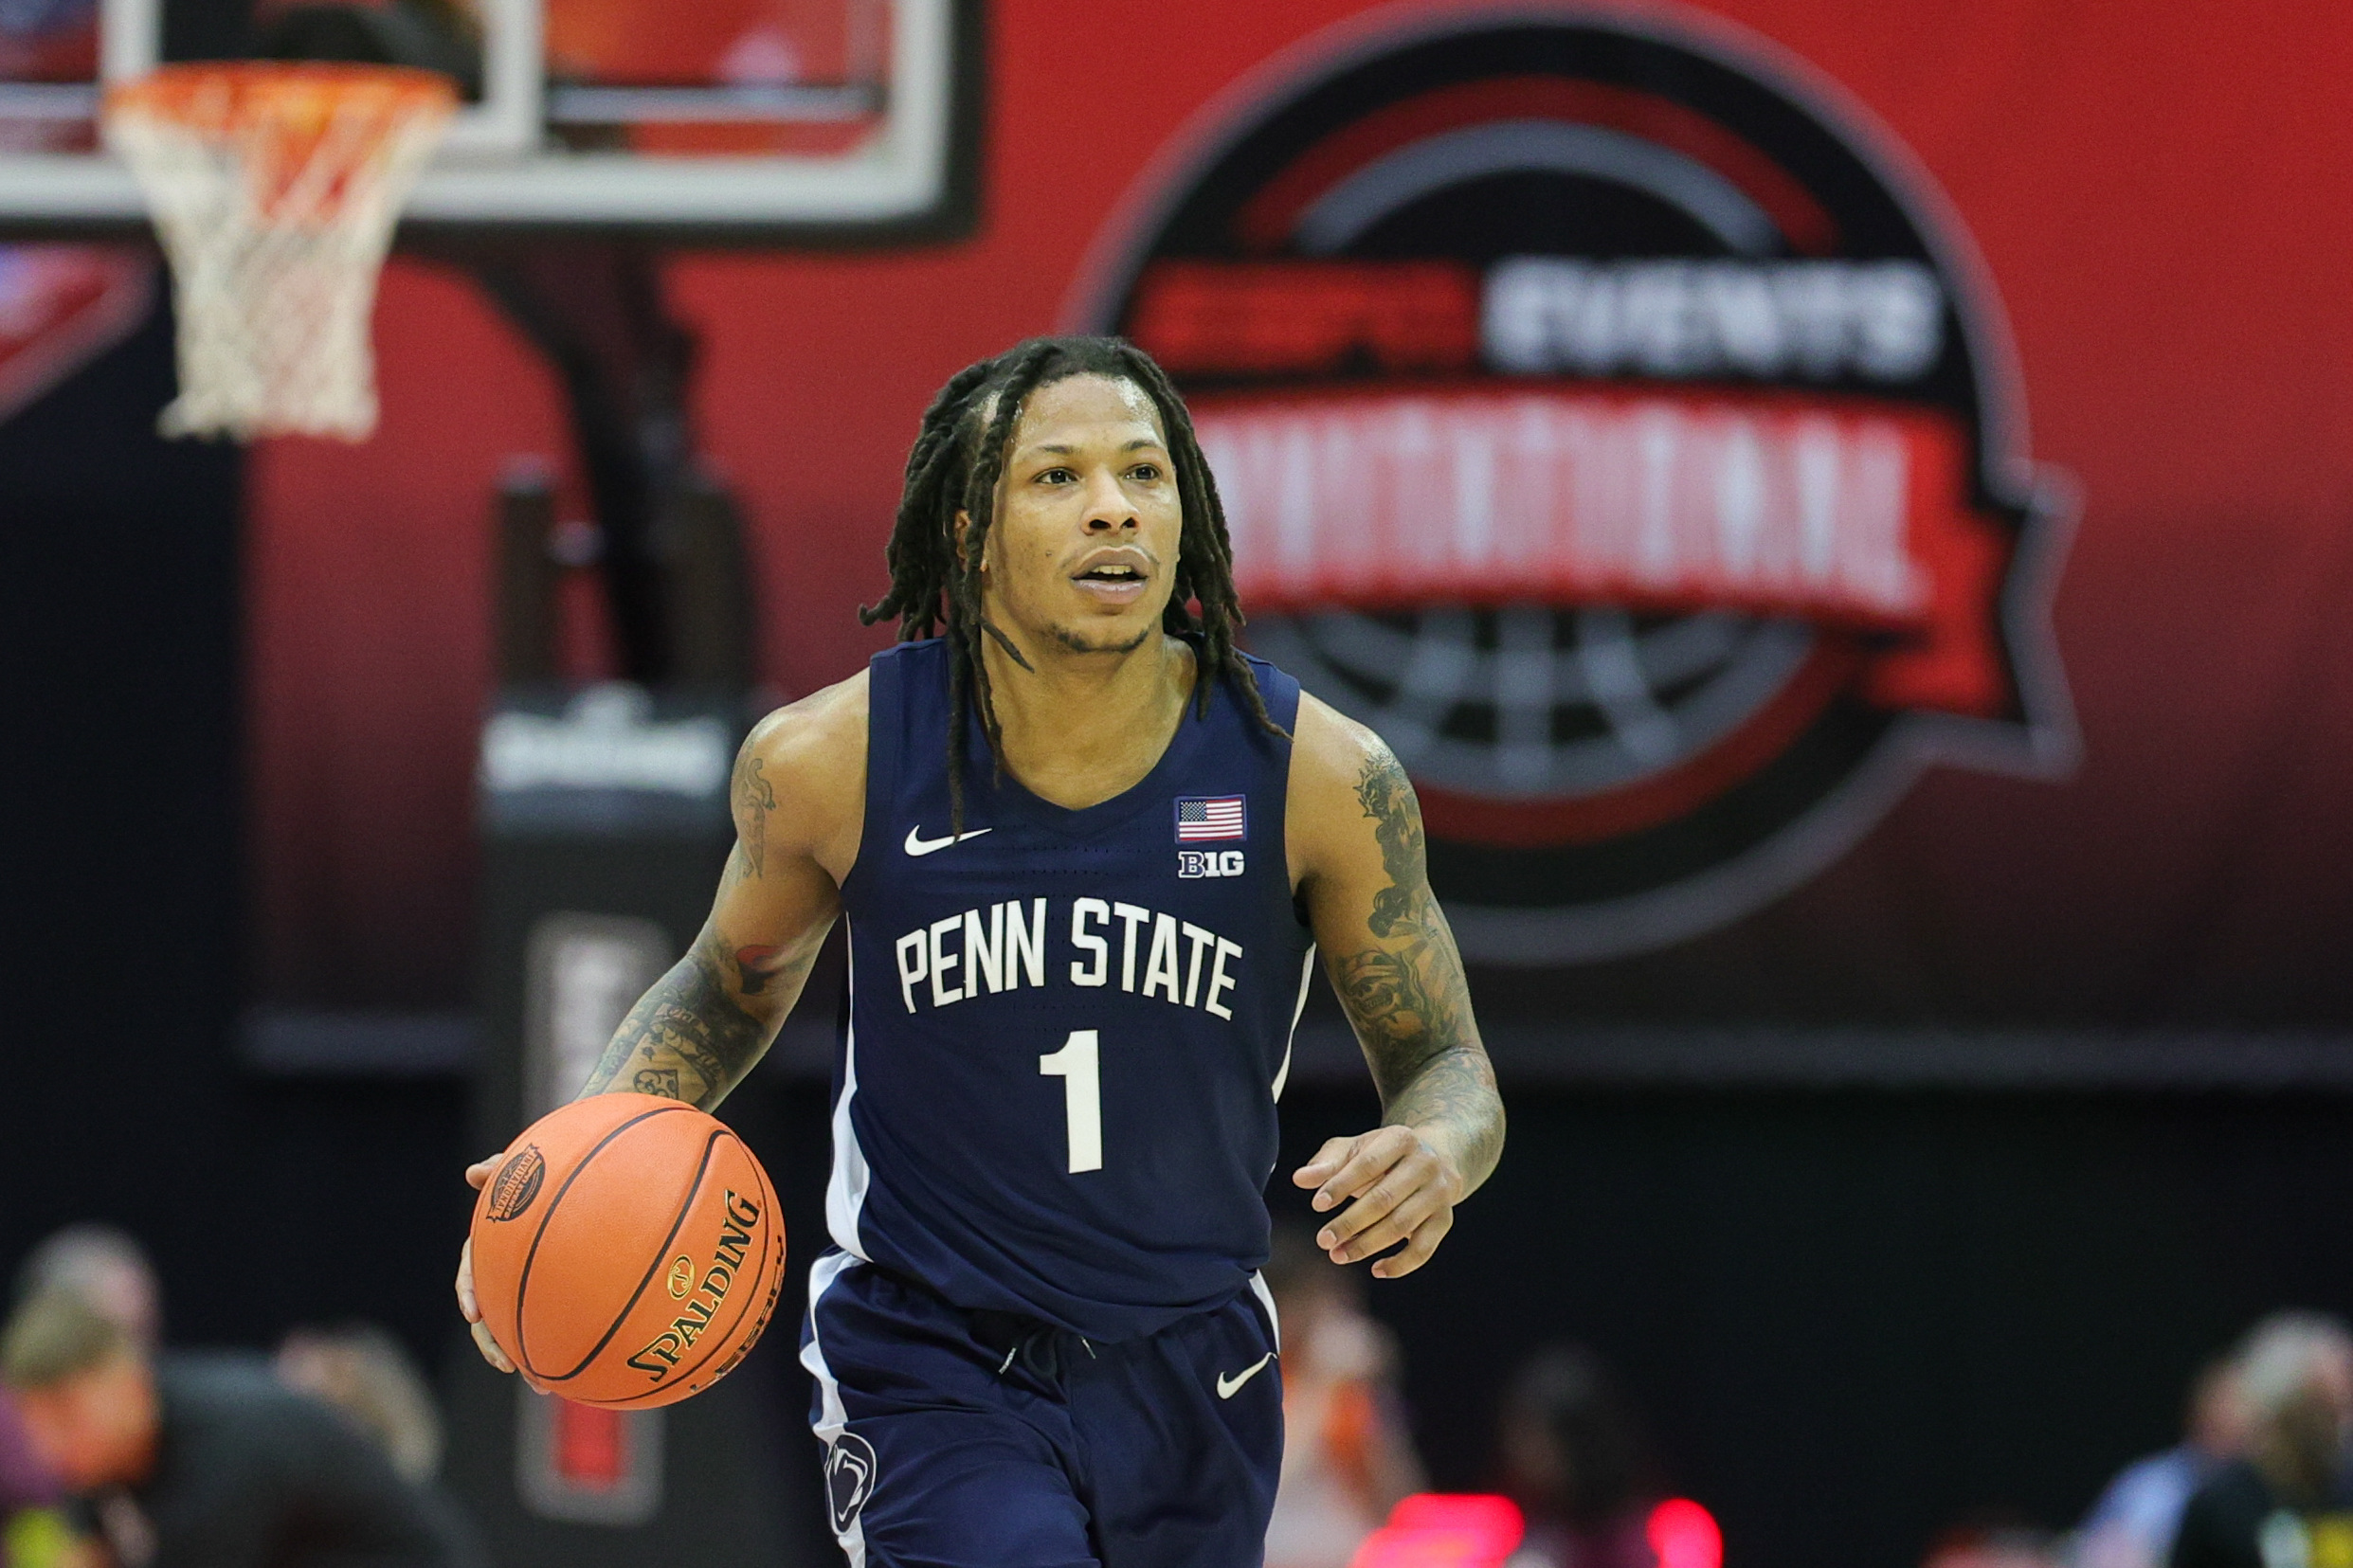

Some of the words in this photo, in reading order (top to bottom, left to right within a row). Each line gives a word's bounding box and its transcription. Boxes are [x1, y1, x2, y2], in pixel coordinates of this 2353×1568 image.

[896, 897, 1047, 1014] PENN
[1070, 896, 1243, 1021] STATE
[1040, 1029, 1102, 1174] 1
[626, 1188, 761, 1383] SPALDING
